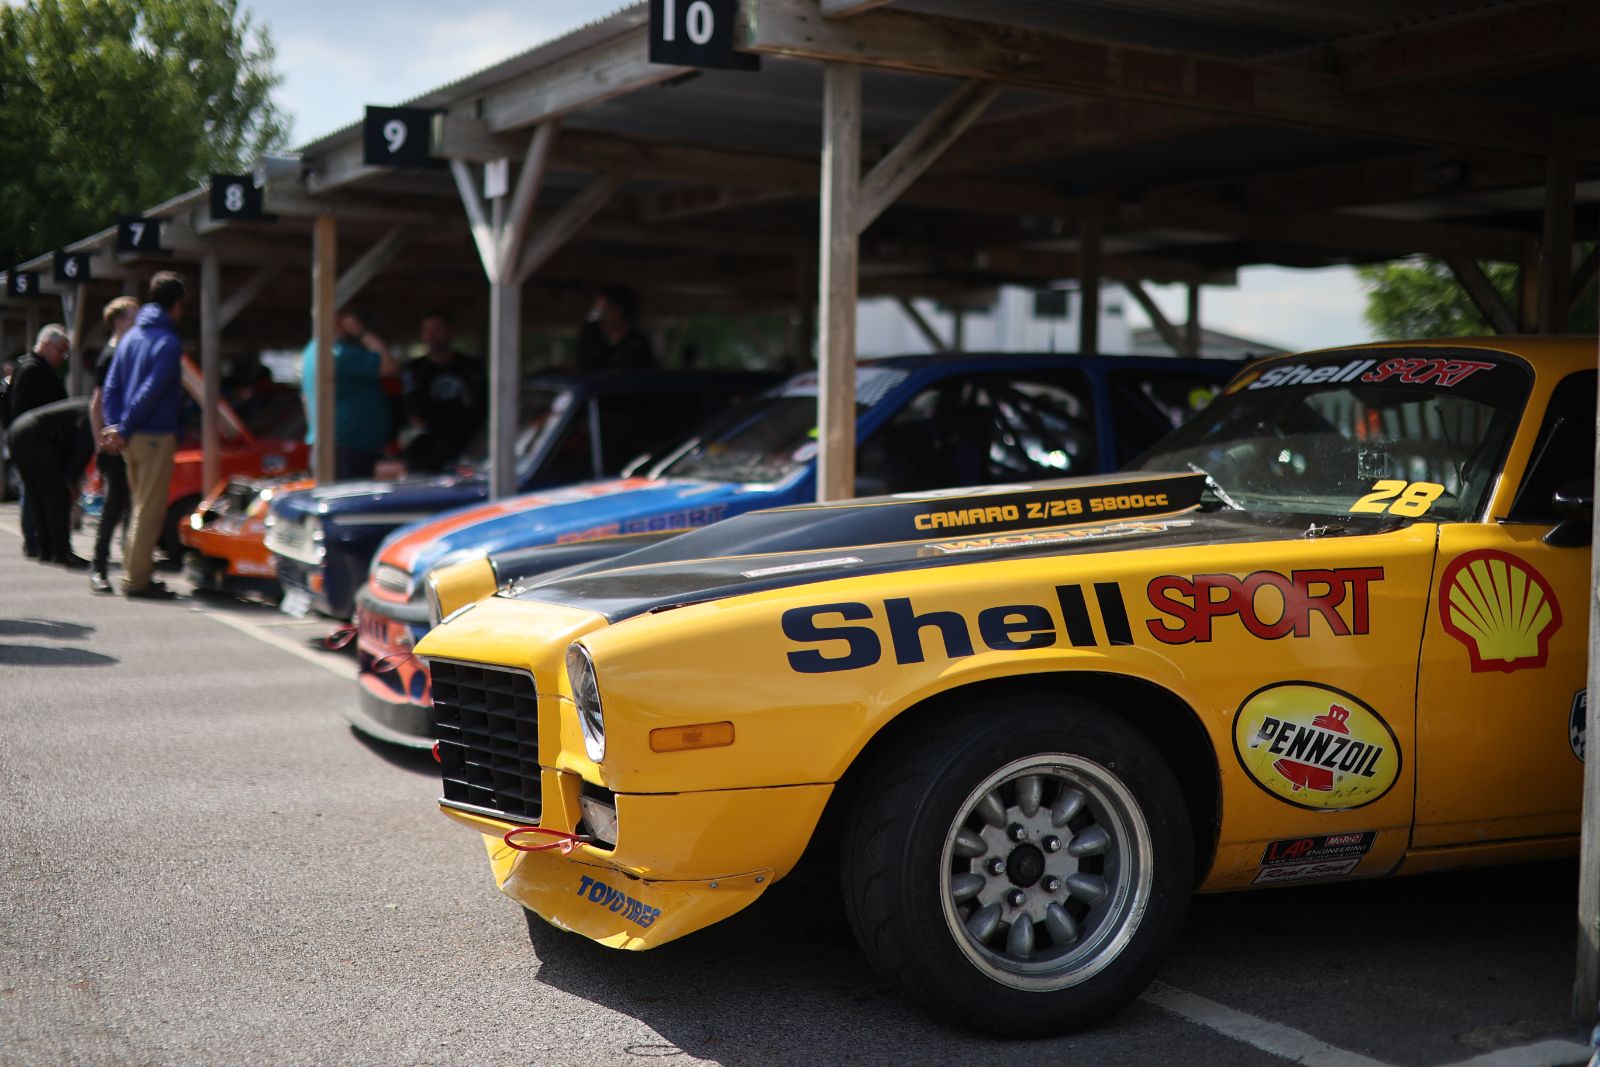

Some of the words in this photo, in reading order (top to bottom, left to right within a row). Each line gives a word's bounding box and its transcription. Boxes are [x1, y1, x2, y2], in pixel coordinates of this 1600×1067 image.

[663, 0, 714, 44] 10
[383, 119, 407, 153] 9
[225, 183, 244, 213] 8
[130, 223, 145, 247] 7
[15, 273, 29, 294] 5
[63, 258, 78, 279] 6
[1248, 359, 1377, 390] Shell
[1361, 357, 1498, 387] SPORT
[914, 504, 1019, 531] CAMARO
[1026, 498, 1082, 520] Z/28
[1090, 493, 1169, 513] 5800cc
[1348, 479, 1445, 518] 28
[780, 581, 1135, 674] Shell
[1146, 566, 1385, 645] SPORT
[1249, 716, 1384, 777] PENNZOIL
[1268, 838, 1314, 860] LAP
[1305, 845, 1367, 857] ENGINEERING
[576, 874, 626, 913] TOYO
[620, 896, 662, 928] TIRES
